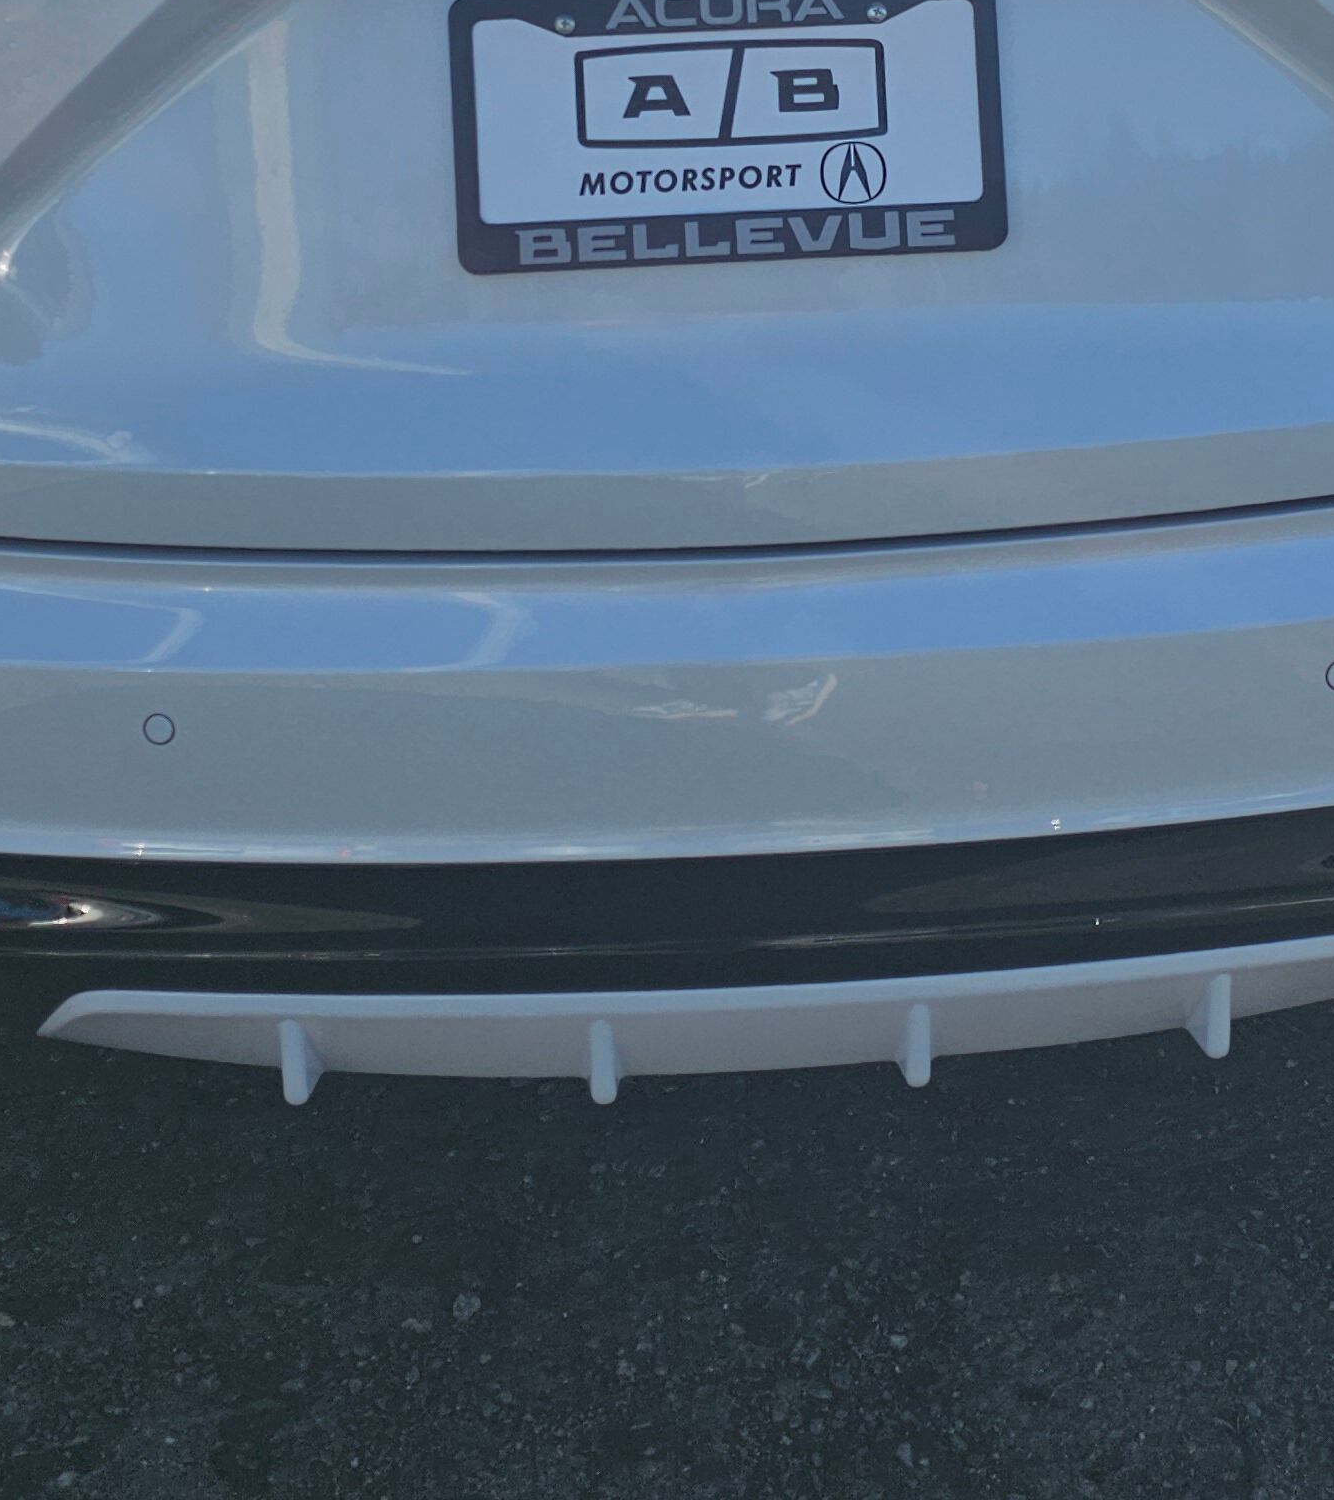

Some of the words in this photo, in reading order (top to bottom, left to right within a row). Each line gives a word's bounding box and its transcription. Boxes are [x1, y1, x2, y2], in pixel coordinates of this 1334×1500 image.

[622, 74, 690, 119] A
[769, 68, 839, 113] B
[579, 164, 802, 197] MOTORSPORT
[515, 209, 956, 266] BELLEVUE
